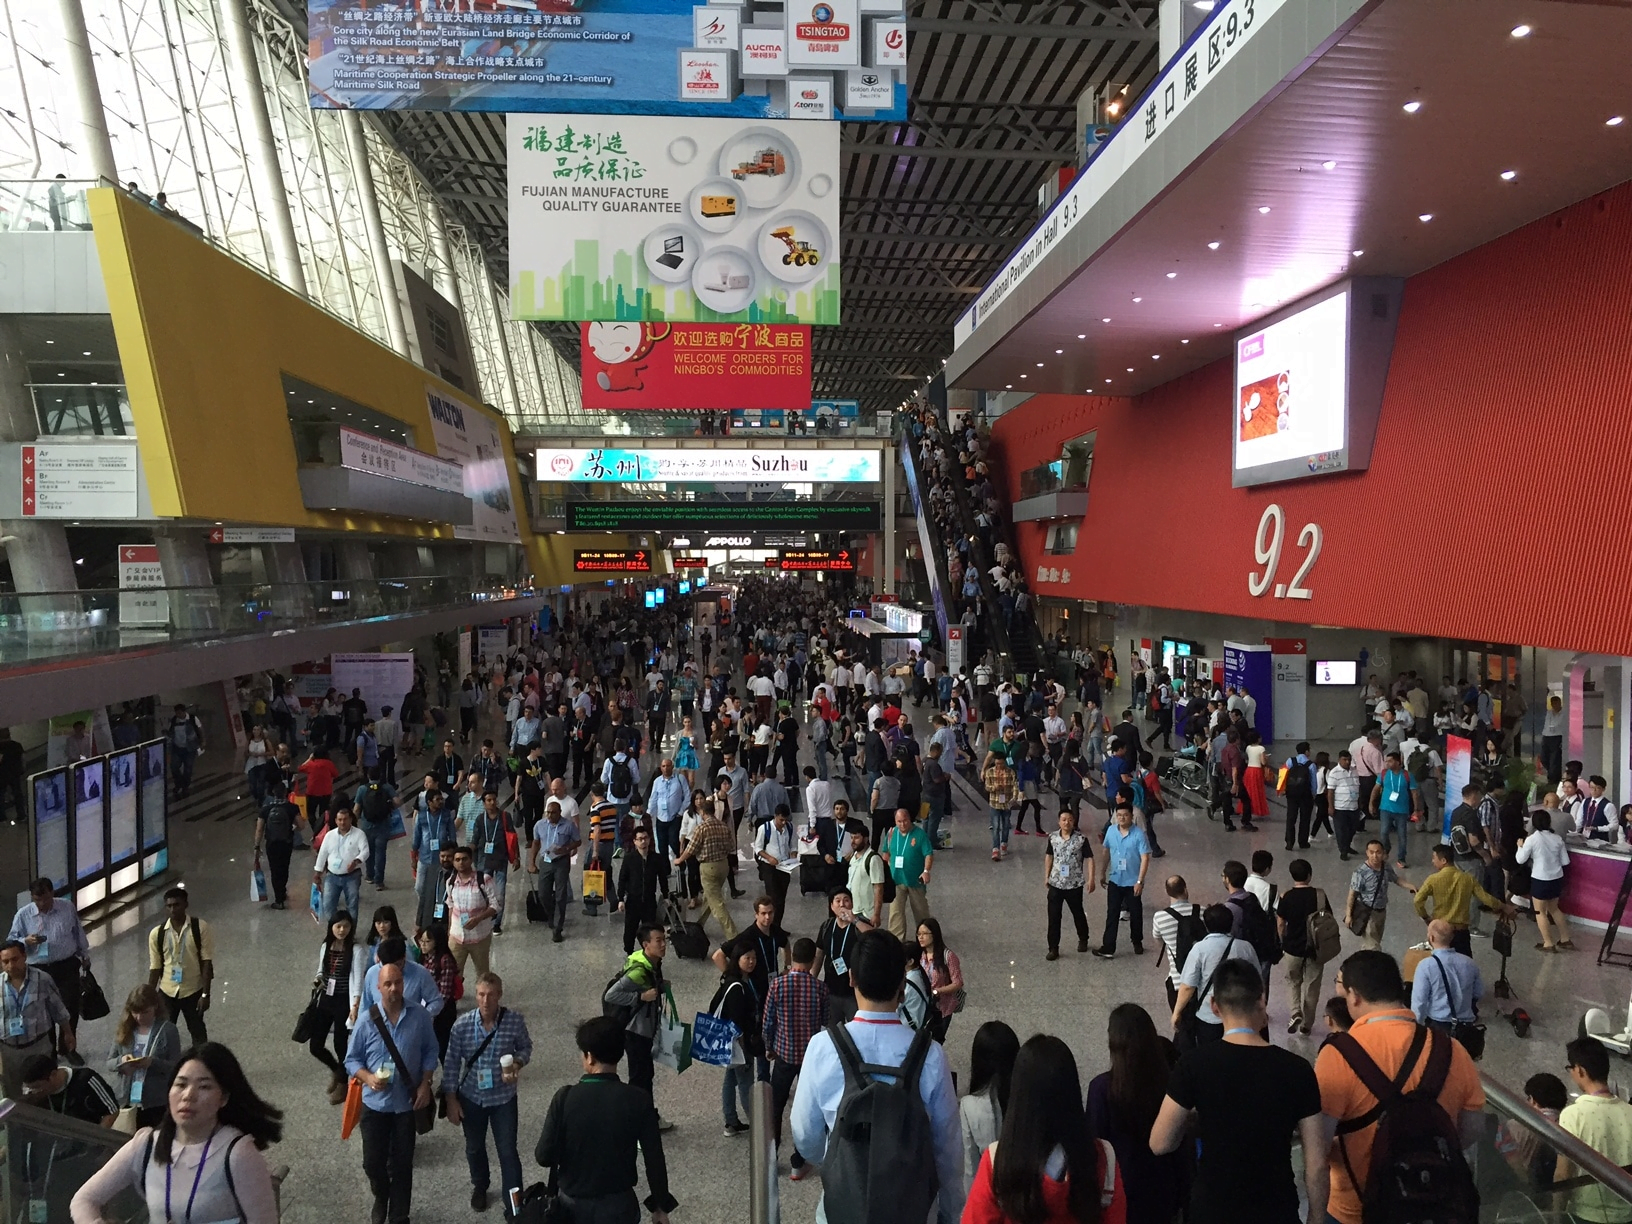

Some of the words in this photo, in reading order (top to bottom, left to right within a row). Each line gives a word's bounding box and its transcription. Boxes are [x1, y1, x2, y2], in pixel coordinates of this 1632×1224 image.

[333, 26, 355, 35] Core
[357, 27, 373, 38] city
[375, 26, 400, 37] along
[402, 26, 417, 36] the
[420, 28, 439, 36] new
[441, 28, 480, 37] Eurasian
[482, 29, 504, 38] Land
[506, 29, 535, 40] Bridge
[537, 30, 580, 39] Economic
[583, 31, 619, 40] Corridor
[621, 32, 631, 40] of
[800, 27, 846, 36] TSINGTAO
[333, 37, 349, 46] the
[351, 37, 367, 46] Silk
[370, 38, 393, 46] Road
[395, 38, 440, 47] Economic
[442, 39, 459, 47] Belt
[808, 43, 839, 53] 青岛啤酒
[334, 70, 375, 79] Maritime
[377, 70, 433, 81] Cooperation
[434, 71, 475, 81] Strategic
[477, 72, 517, 81] Propeller
[519, 73, 544, 82] along
[546, 73, 560, 82] the
[334, 81, 375, 89] Maritime
[377, 81, 394, 89] Silk
[396, 81, 420, 89] Road
[522, 124, 627, 155] 福建制造
[553, 155, 648, 182] 品质保证
[521, 185, 568, 198] FUJIAN
[571, 186, 669, 199] MANUFACTURE
[542, 200, 599, 212] QUALITY
[602, 201, 682, 214] GUARANTEE
[978, 270, 1010, 319] International
[1010, 249, 1035, 286] Pavilion
[1035, 239, 1042, 259] in
[1043, 216, 1058, 249] Hall
[1063, 195, 1078, 228] 9.3
[673, 324, 804, 349] 欢迎选购宁波商品
[674, 353, 726, 364] WELCOME
[732, 354, 776, 364] ORDERS
[782, 354, 804, 364] FOR
[674, 365, 724, 375] NINGBO'S
[730, 365, 803, 375] COMMODITIES
[427, 392, 466, 433] WALTON
[347, 434, 370, 451] Conference
[380, 444, 398, 459] Reception
[584, 450, 642, 480] 苏州
[752, 454, 808, 472] Suzhou
[705, 537, 752, 546] APPOLLO
[1249, 503, 1323, 600] 9.2
